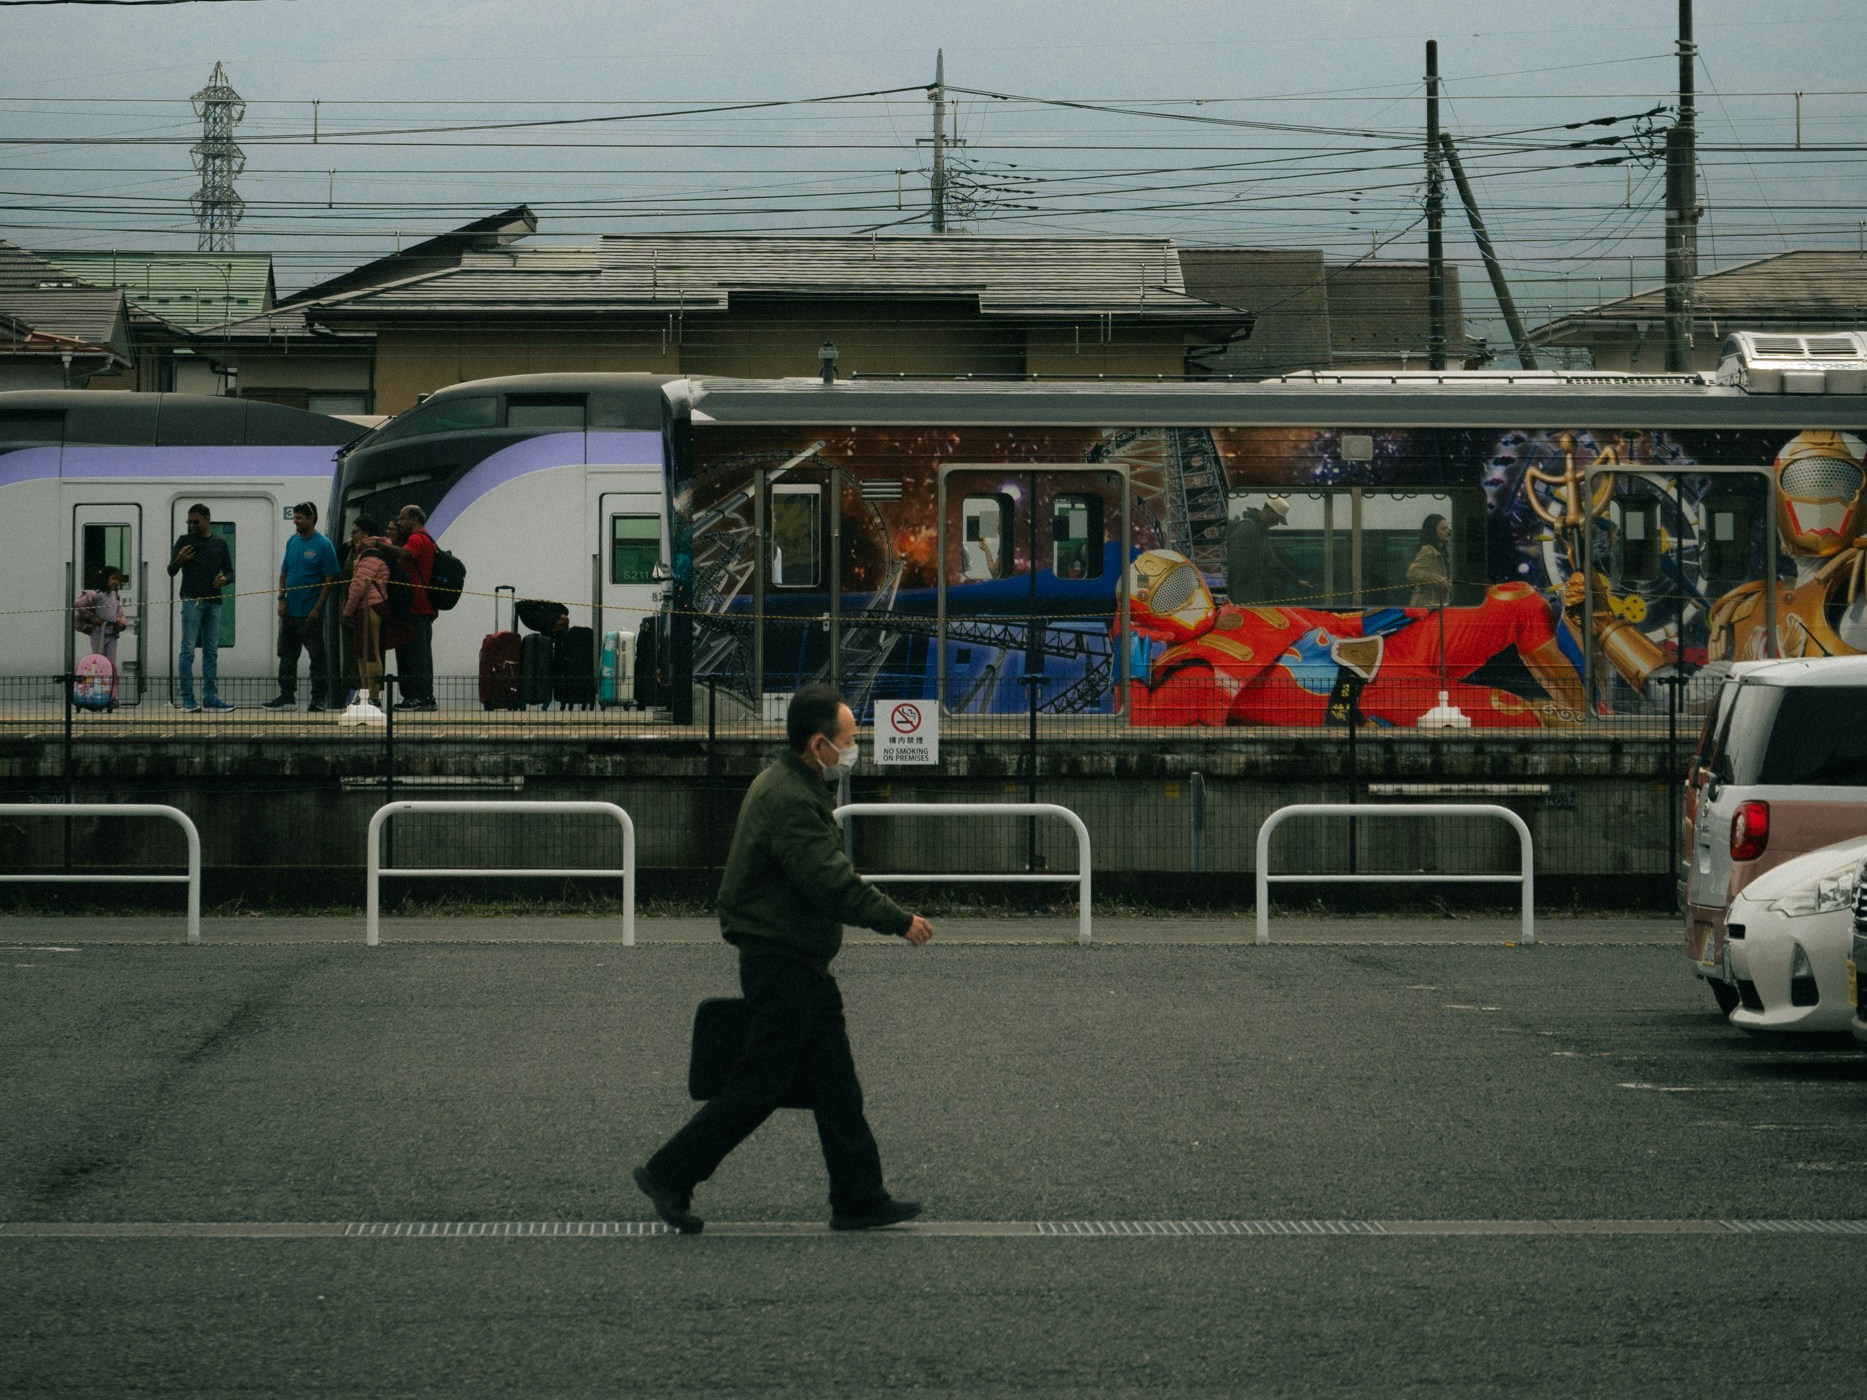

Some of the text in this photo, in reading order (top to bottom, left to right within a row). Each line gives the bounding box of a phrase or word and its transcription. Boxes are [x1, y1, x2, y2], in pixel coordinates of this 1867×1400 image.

[286, 508, 294, 518] 3
[623, 570, 649, 580] S211
[889, 736, 924, 744] 構内禁煙
